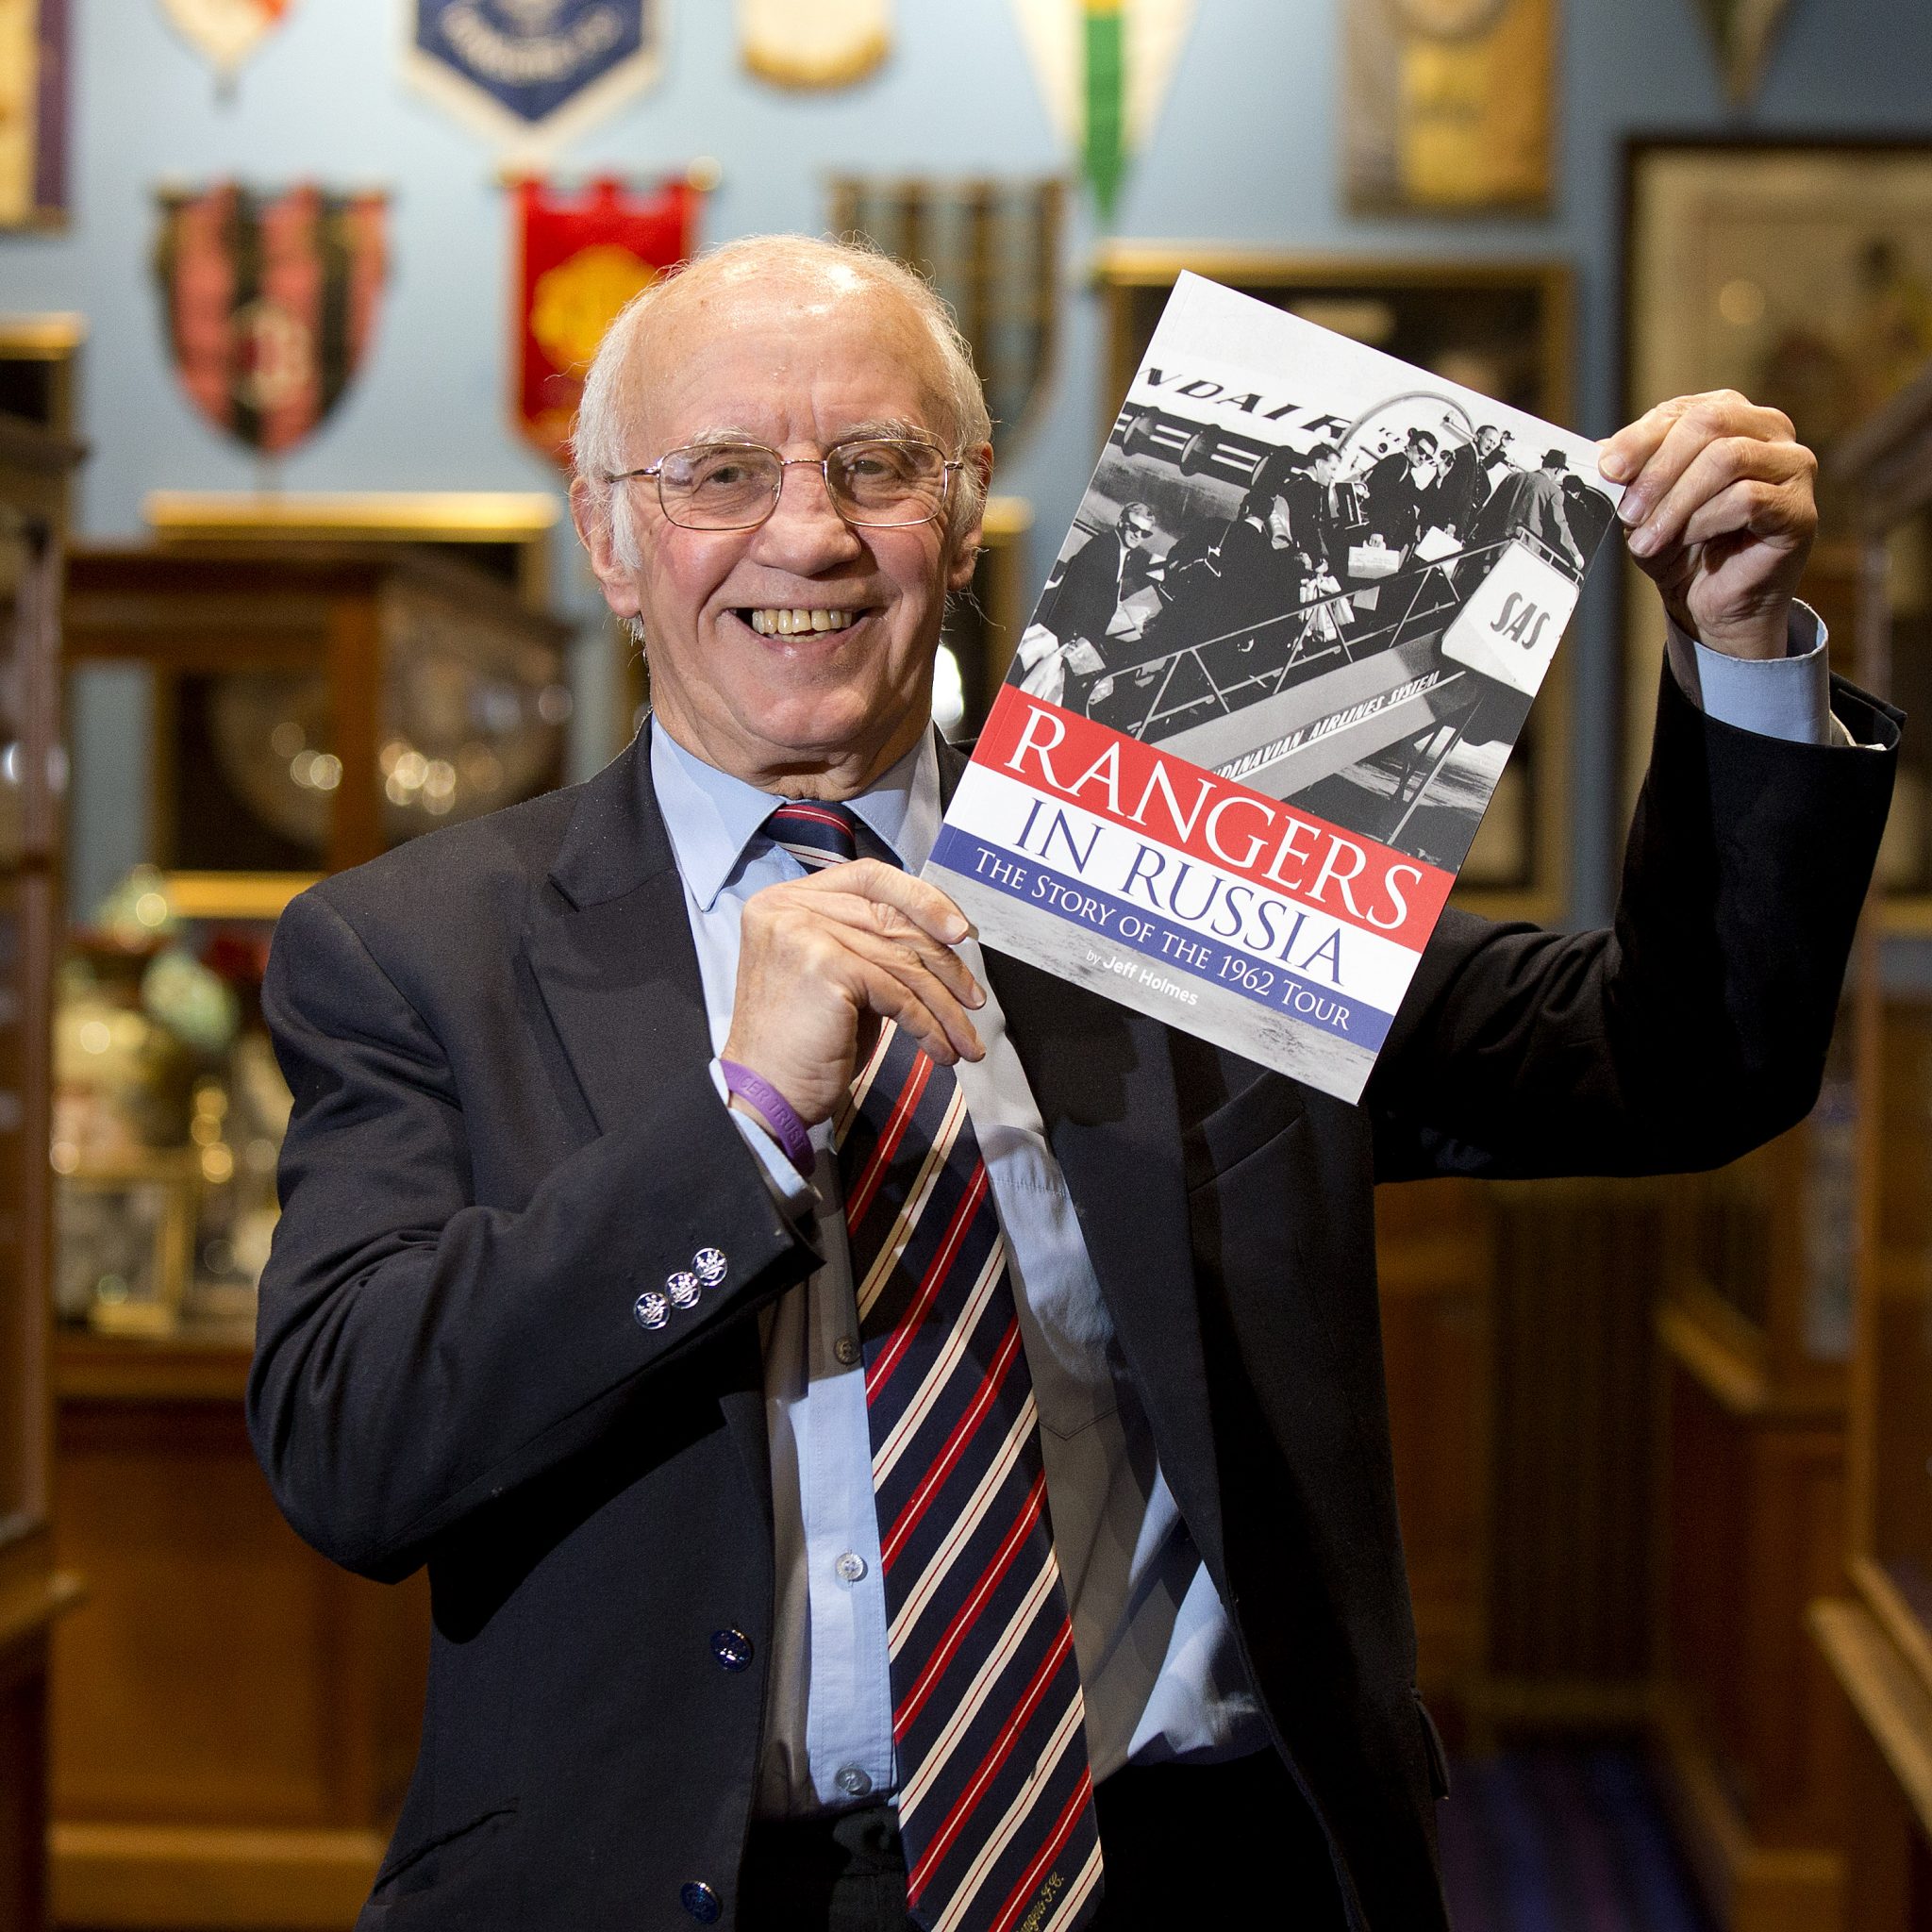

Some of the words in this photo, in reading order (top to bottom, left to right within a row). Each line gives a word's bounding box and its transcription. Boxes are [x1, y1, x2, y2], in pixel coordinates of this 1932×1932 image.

[1491, 591, 1550, 650] SAS
[1308, 696, 1385, 741] AIRLINES
[1388, 670, 1441, 706] SYSTEM
[1004, 704, 1423, 929] RANGERS
[976, 847, 1026, 889] THE
[1031, 875, 1117, 933] STORY
[1119, 915, 1153, 945] OF
[1162, 932, 1212, 969] THE
[1218, 956, 1274, 996] 1962
[1281, 983, 1350, 1031] TOUR
[1013, 797, 1106, 874] IN
[1118, 843, 1347, 987] RUSSIA
[1086, 949, 1101, 966] by
[1102, 955, 1138, 979] Jeff
[1139, 969, 1199, 1007] Holmes
